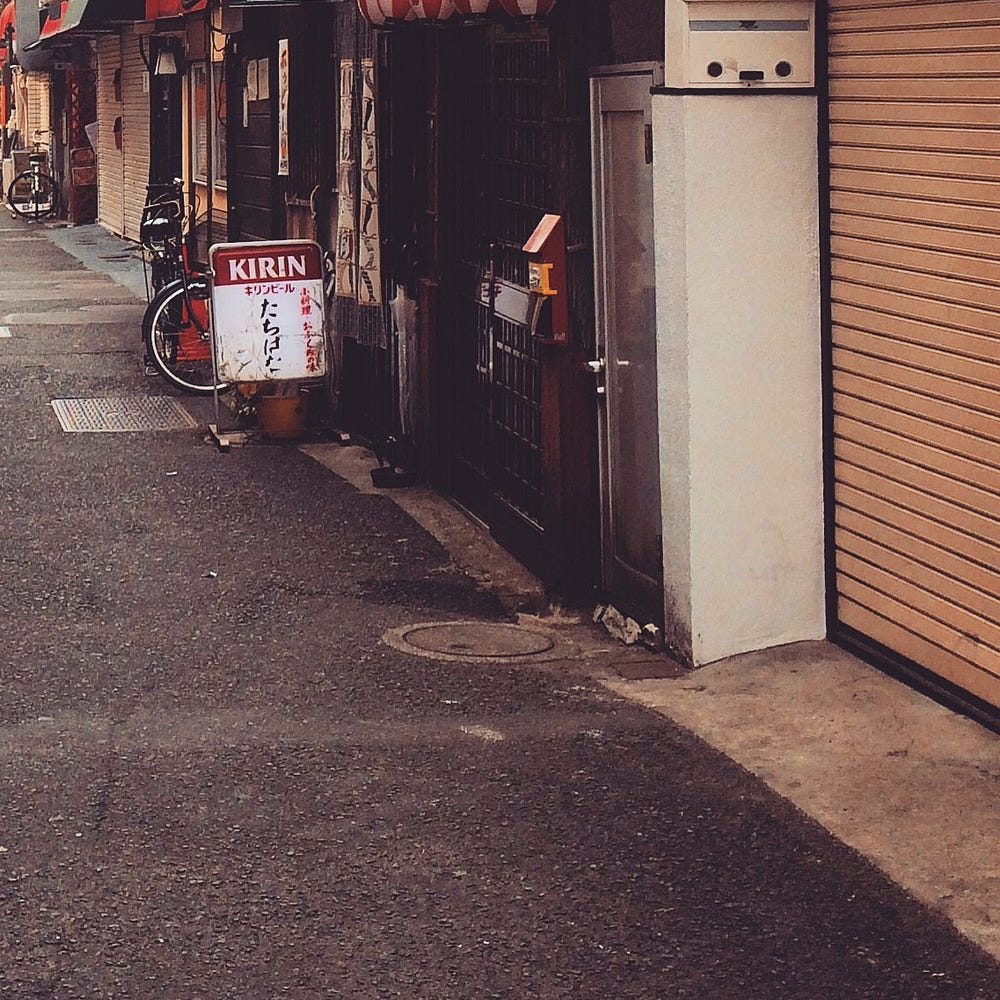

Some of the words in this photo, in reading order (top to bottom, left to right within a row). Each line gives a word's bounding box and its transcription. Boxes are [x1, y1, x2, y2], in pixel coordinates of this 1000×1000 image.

[228, 255, 306, 281] KIRIN
[244, 283, 296, 297] キリンビール
